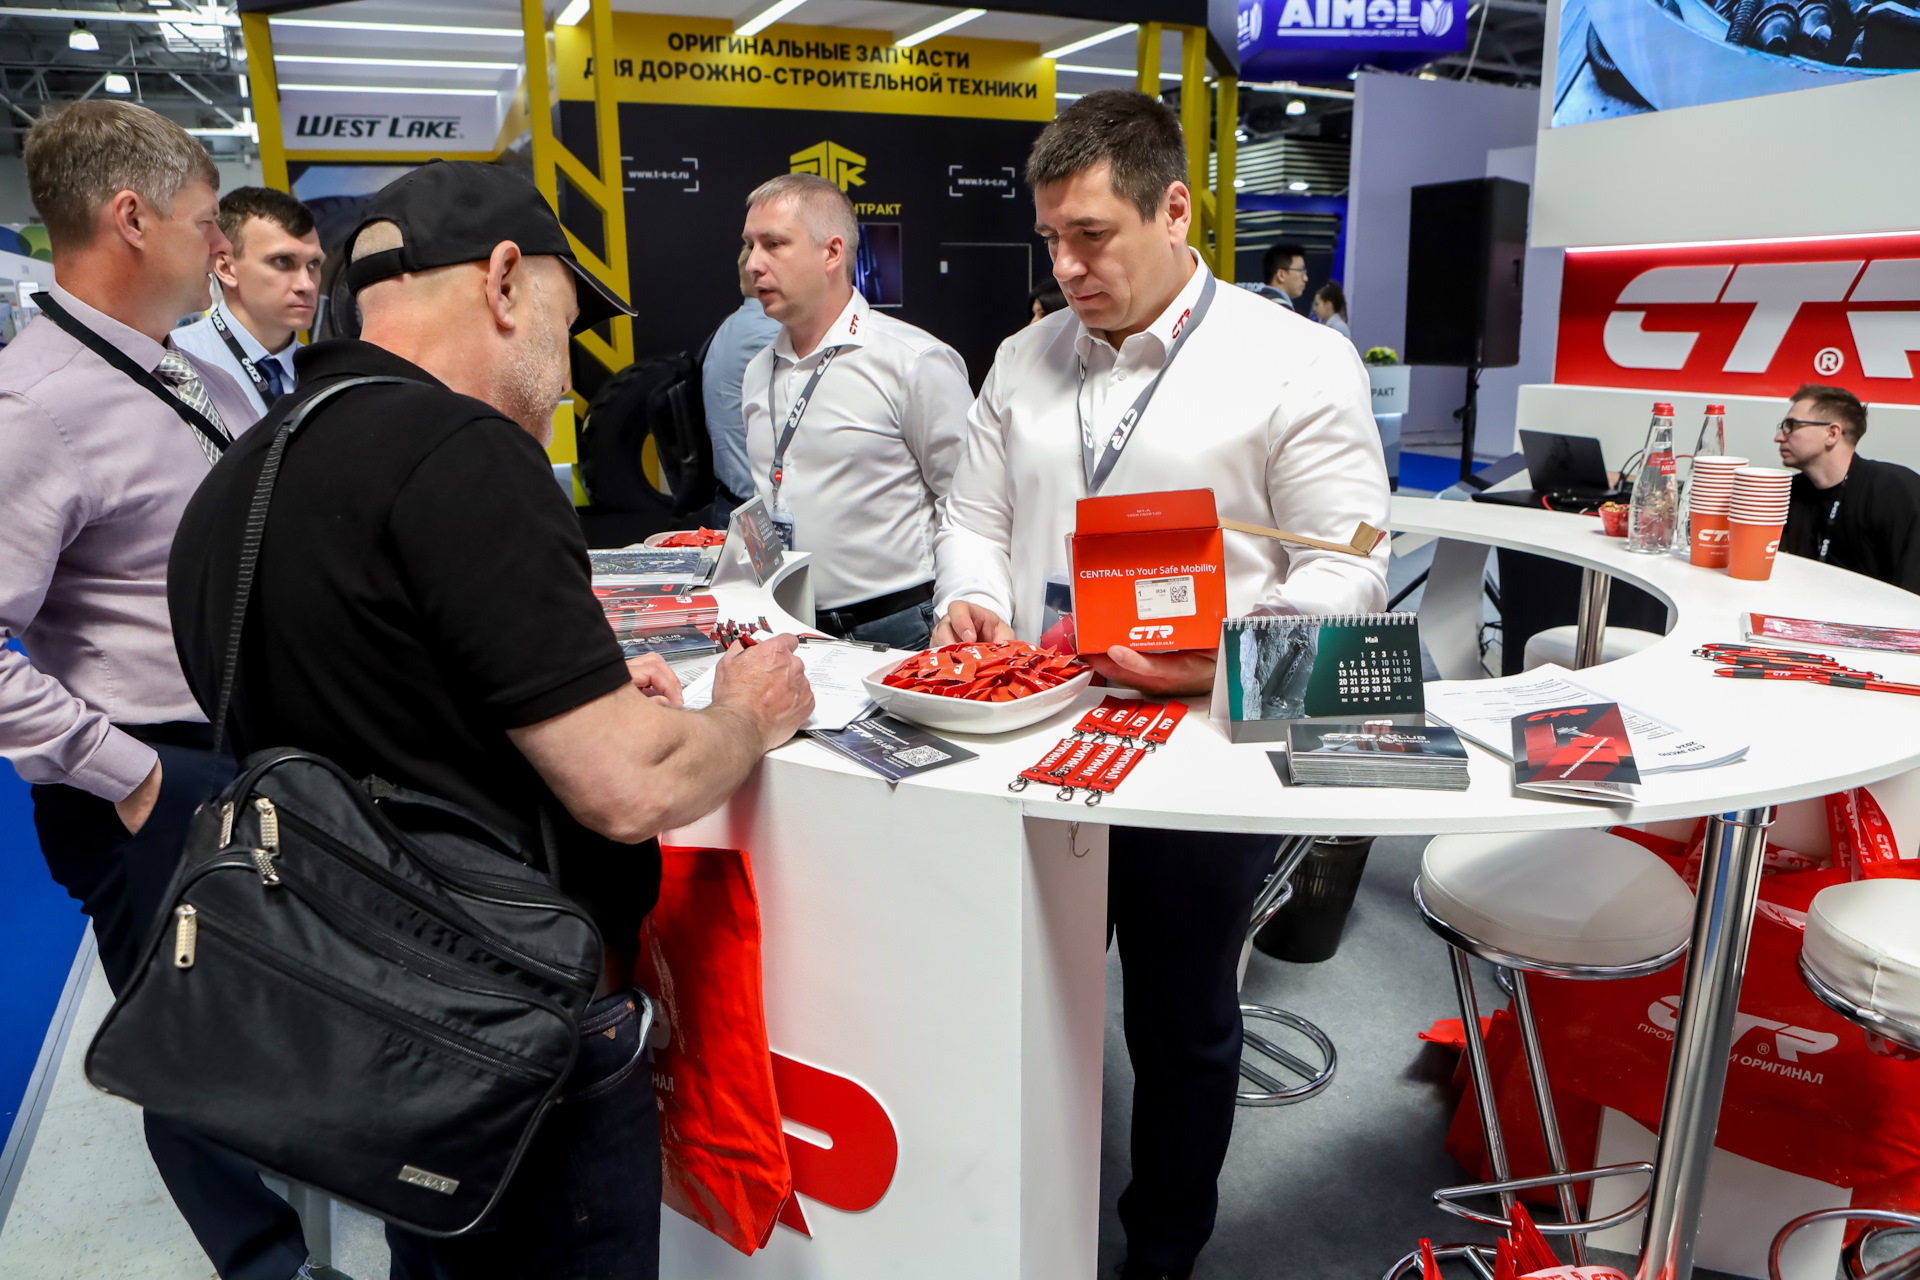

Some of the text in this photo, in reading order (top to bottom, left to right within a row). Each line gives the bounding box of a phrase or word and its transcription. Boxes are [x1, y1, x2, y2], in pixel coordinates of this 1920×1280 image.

[668, 33, 969, 68] ОРИГИНАЛЬНЫЕ ЗАПЧАСТИ
[583, 57, 1037, 99] ДЯ ДОРОЖНО-СТРОИТЕЛЬНОЙ ТЕХНИКИ
[628, 170, 690, 180] www.t-s-c.ru
[789, 397, 807, 429] CTR
[1111, 408, 1138, 451] CTR
[1079, 562, 1217, 579] CENTRAL to Your Safe Mobility
[1128, 624, 1174, 640] CTR
[1364, 636, 1379, 644] Май
[1361, 651, 1365, 659] 1
[1381, 650, 1387, 658] 3
[1403, 649, 1408, 657] 5
[1350, 660, 1355, 668] 7
[1402, 658, 1411, 666] 12
[1338, 669, 1347, 677] 13
[1360, 668, 1369, 676] 15
[1371, 668, 1379, 676] 16
[1381, 667, 1390, 675] 17
[1338, 678, 1348, 686] 20
[1360, 677, 1369, 685] 22
[1382, 676, 1391, 684] 24
[1350, 686, 1359, 694] 28
[1527, 708, 1589, 722] CTR
[1040, 739, 1076, 768] ОРИГИНАЛ
[1081, 745, 1118, 777] ОРИГИНАЛ
[1105, 748, 1138, 780] ОРИГИНАЛ
[1740, 1055, 1824, 1085] ОРИГИНАЛ
